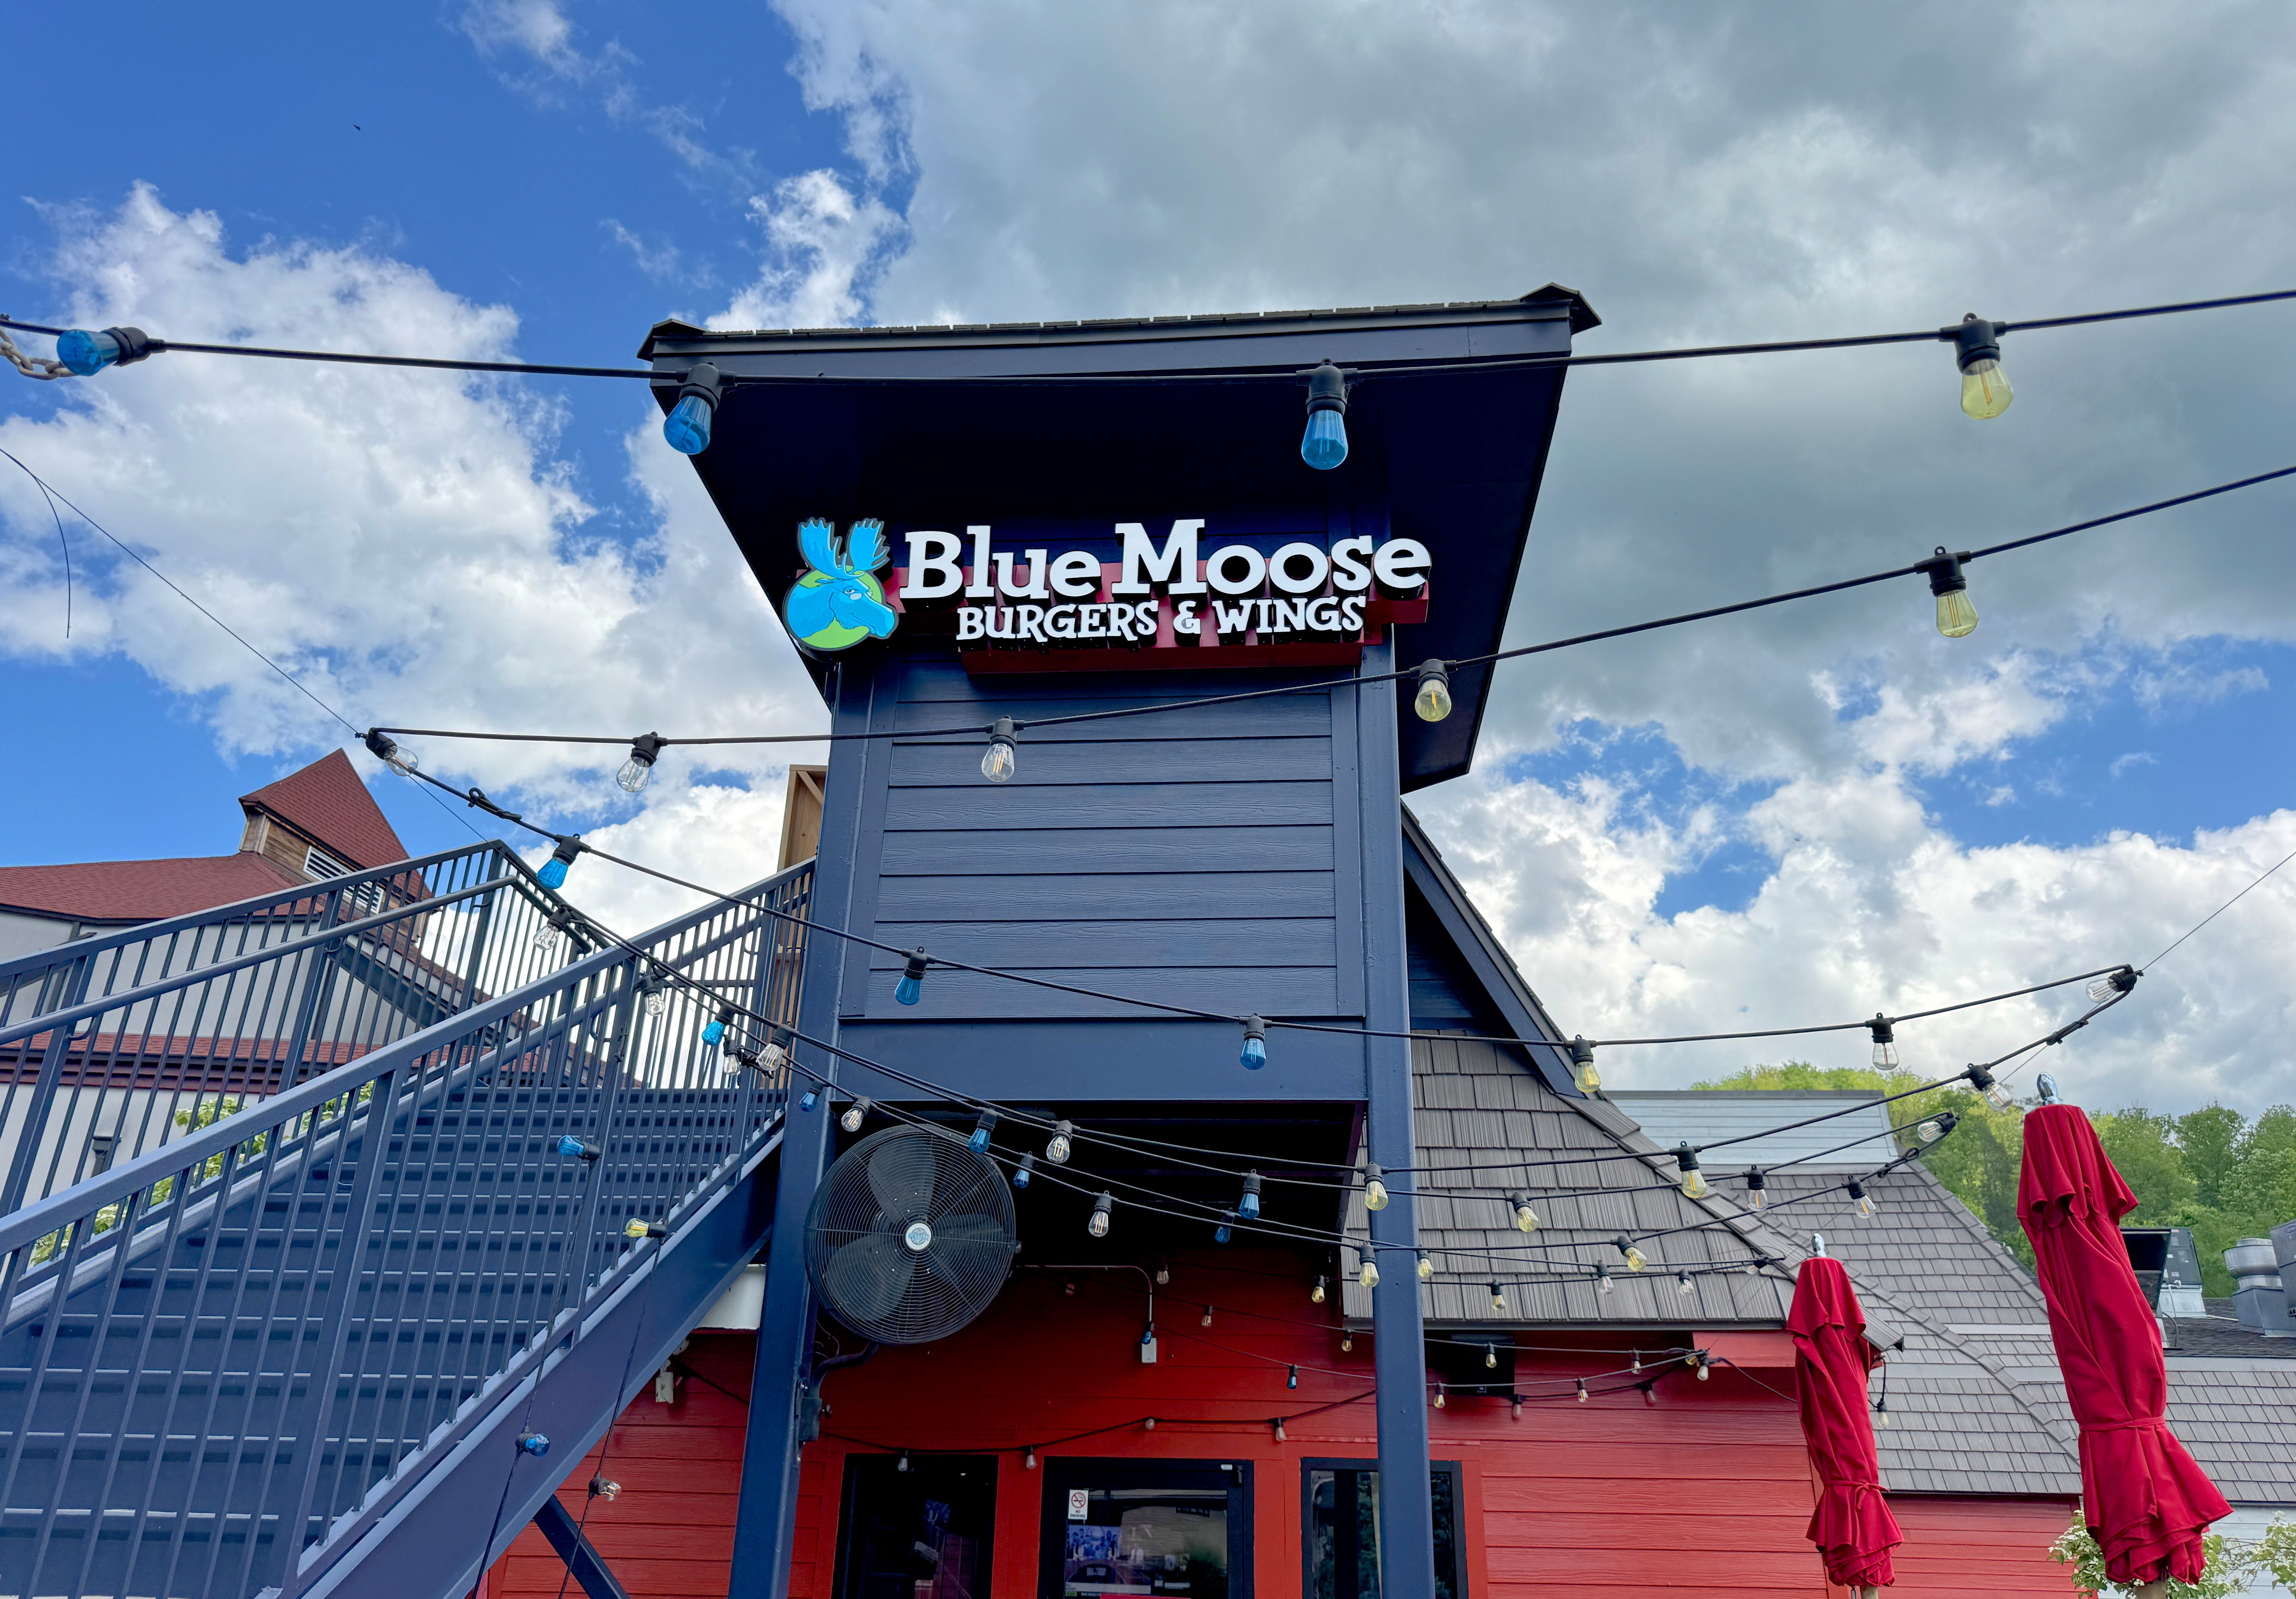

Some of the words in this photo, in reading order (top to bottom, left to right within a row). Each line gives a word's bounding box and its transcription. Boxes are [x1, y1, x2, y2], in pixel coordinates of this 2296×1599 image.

[900, 525, 1101, 599] Blue
[1111, 519, 1431, 594] Moose
[956, 600, 1159, 642] BURGERS
[1173, 600, 1201, 634] &
[1212, 595, 1366, 634] WINGS
